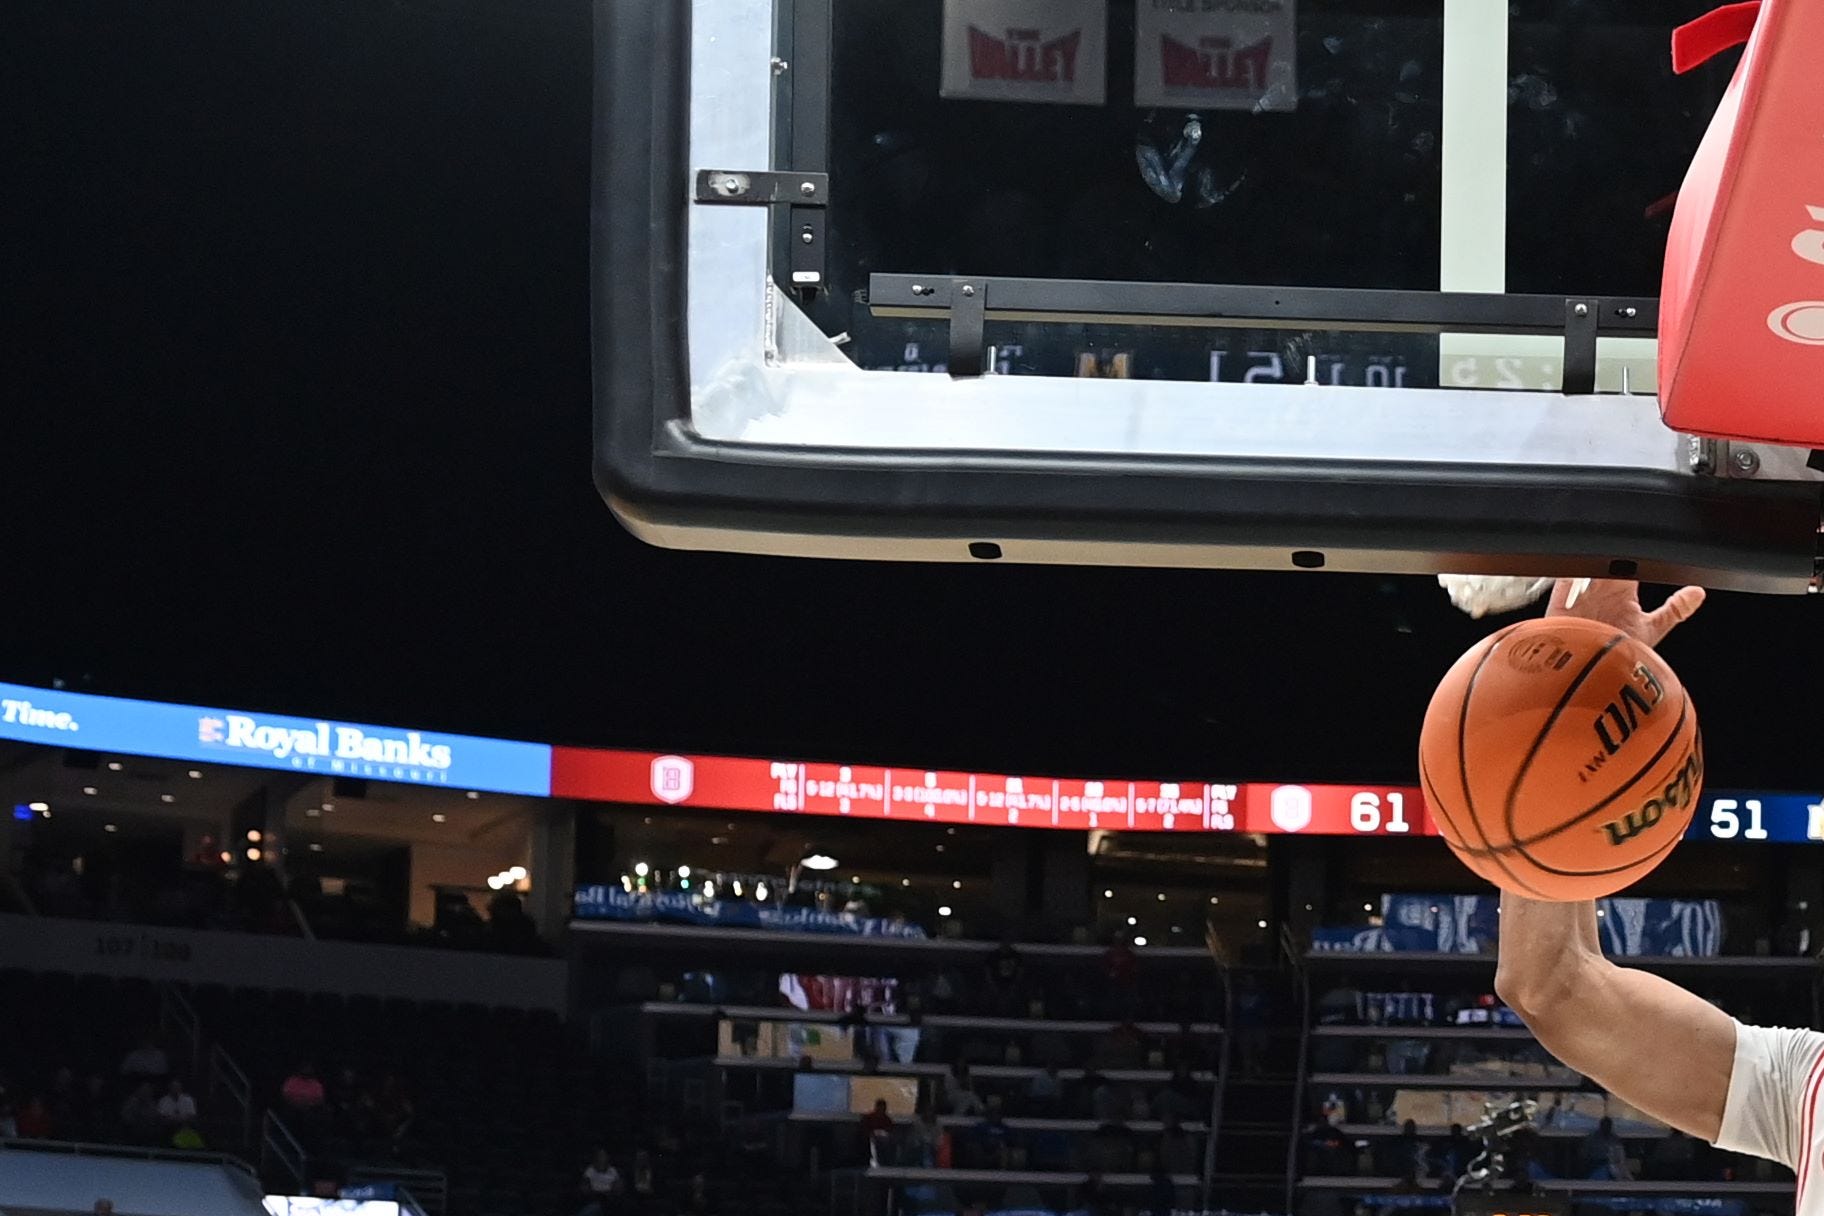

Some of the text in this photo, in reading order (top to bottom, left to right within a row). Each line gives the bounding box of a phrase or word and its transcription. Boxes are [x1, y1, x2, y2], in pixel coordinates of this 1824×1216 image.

[2, 699, 80, 732] Time.
[225, 714, 452, 770] Royal Banks
[1350, 792, 1410, 833] 61
[1709, 799, 1768, 840] 51
